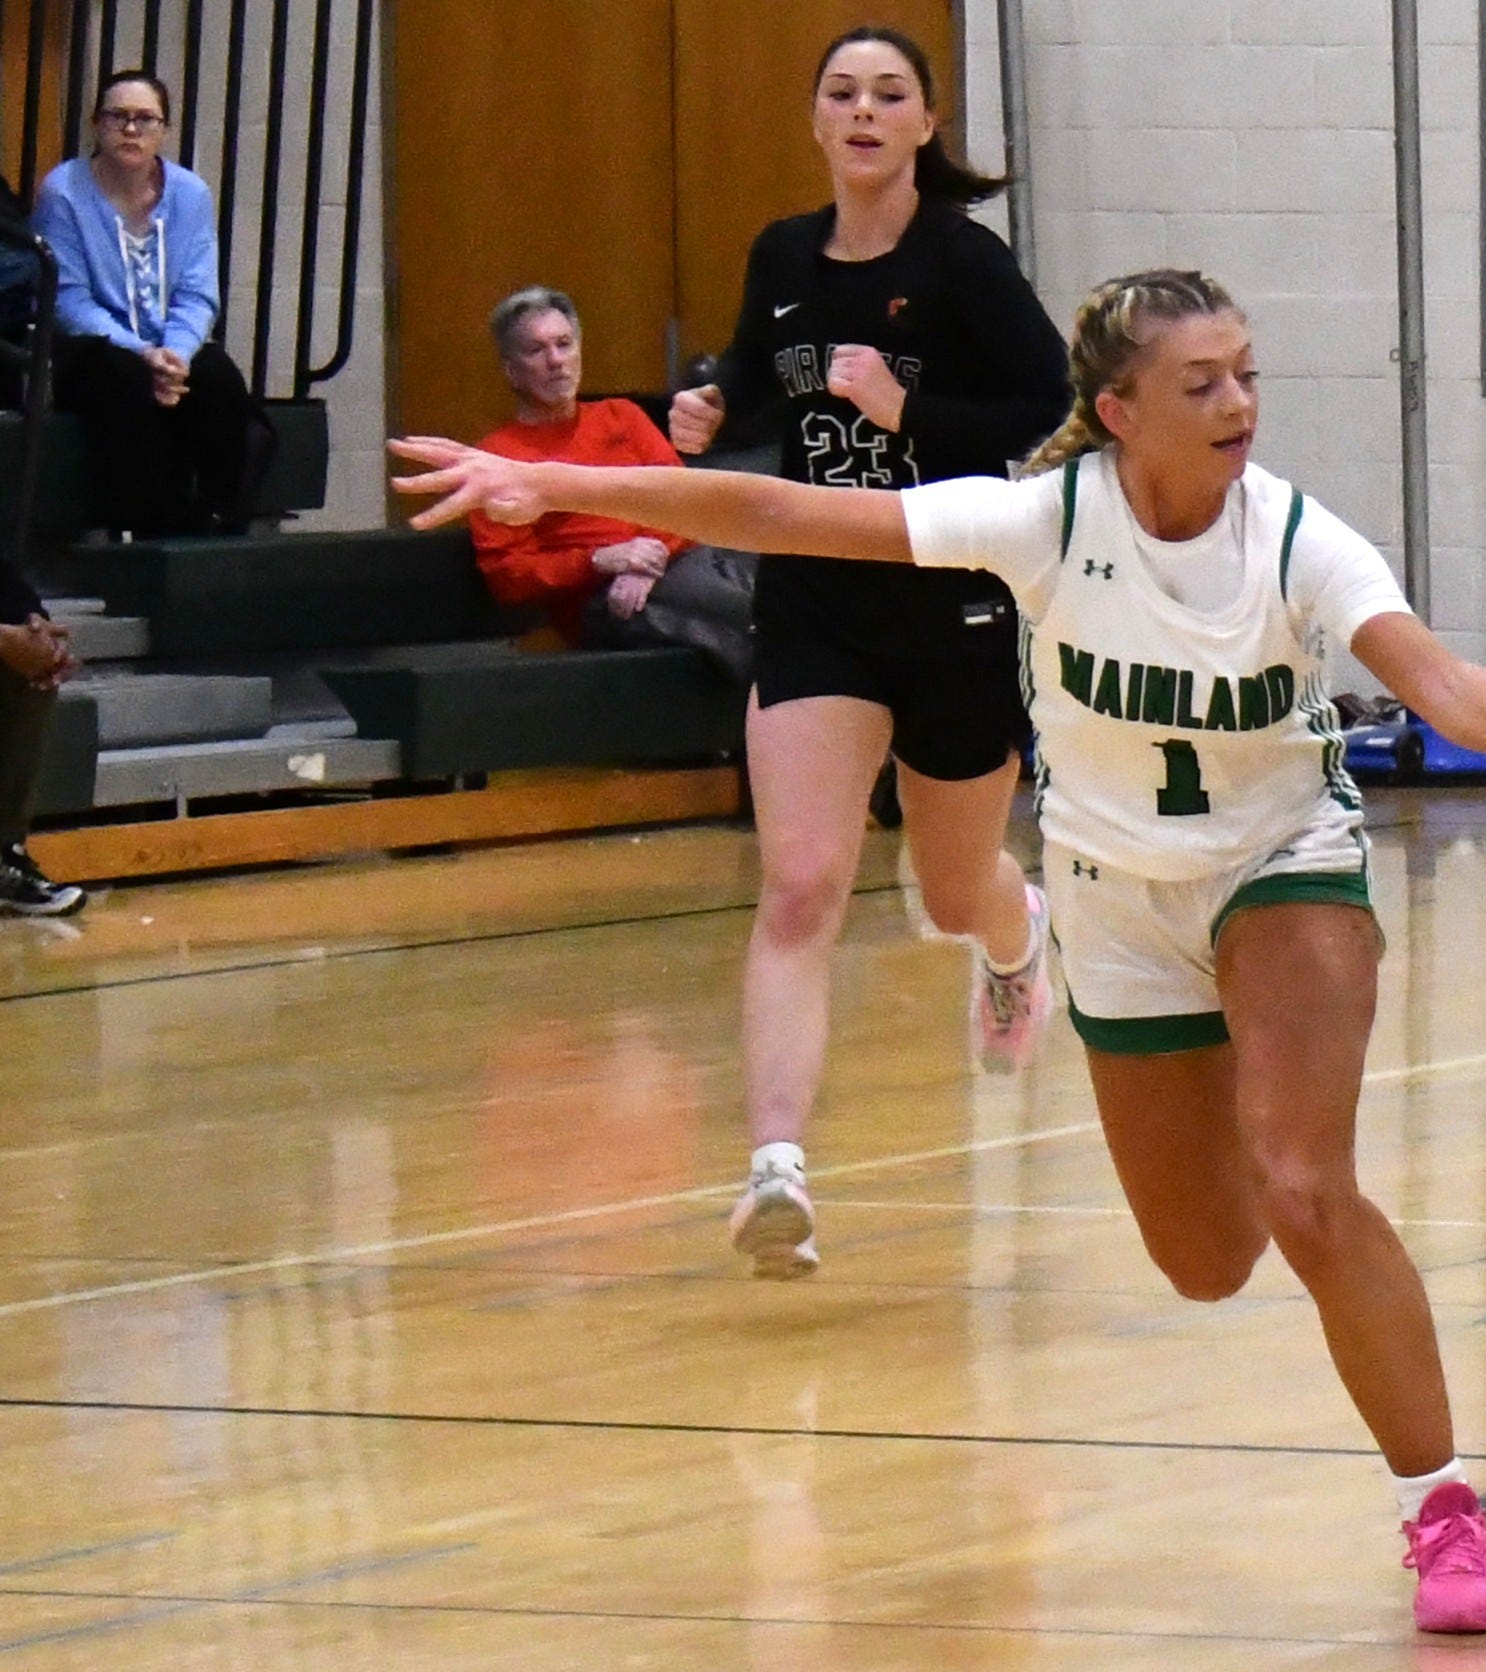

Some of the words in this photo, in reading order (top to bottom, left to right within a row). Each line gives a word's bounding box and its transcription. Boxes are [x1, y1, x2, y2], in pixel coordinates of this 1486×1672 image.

[801, 411, 920, 487] 23
[1058, 641, 1295, 732] MAINLAND
[1152, 738, 1210, 816] 1
